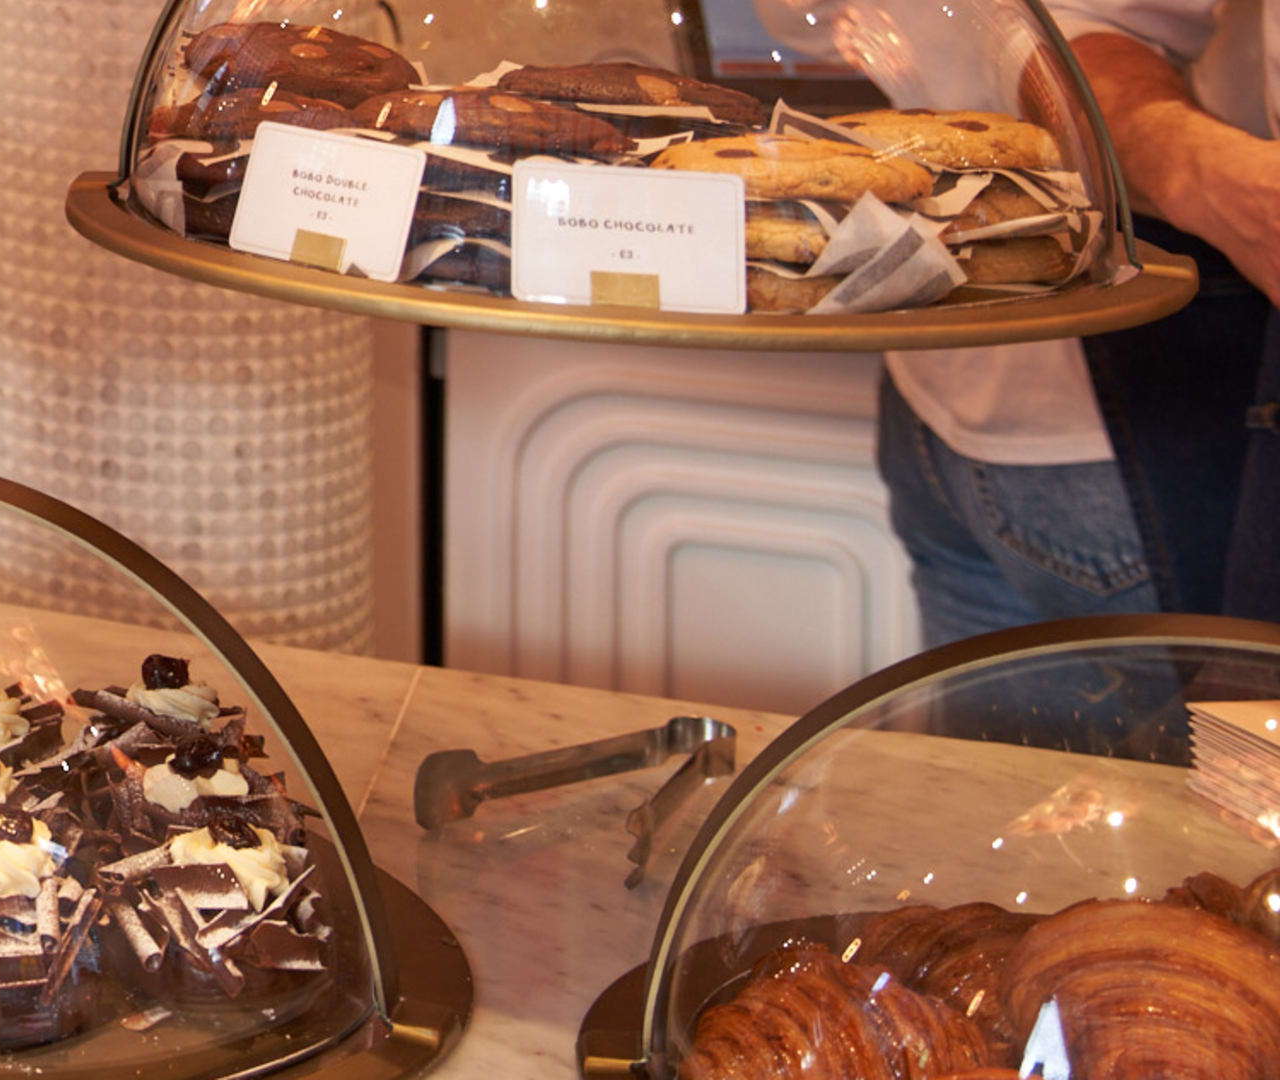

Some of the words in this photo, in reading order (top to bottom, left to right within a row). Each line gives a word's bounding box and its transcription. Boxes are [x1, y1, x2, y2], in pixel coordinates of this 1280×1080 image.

[292, 169, 322, 182] BOBO
[326, 174, 368, 191] DOUBLE
[293, 186, 358, 207] CHOCOLATE
[558, 216, 599, 229] BOBO
[603, 220, 695, 235] CHOCOLATE
